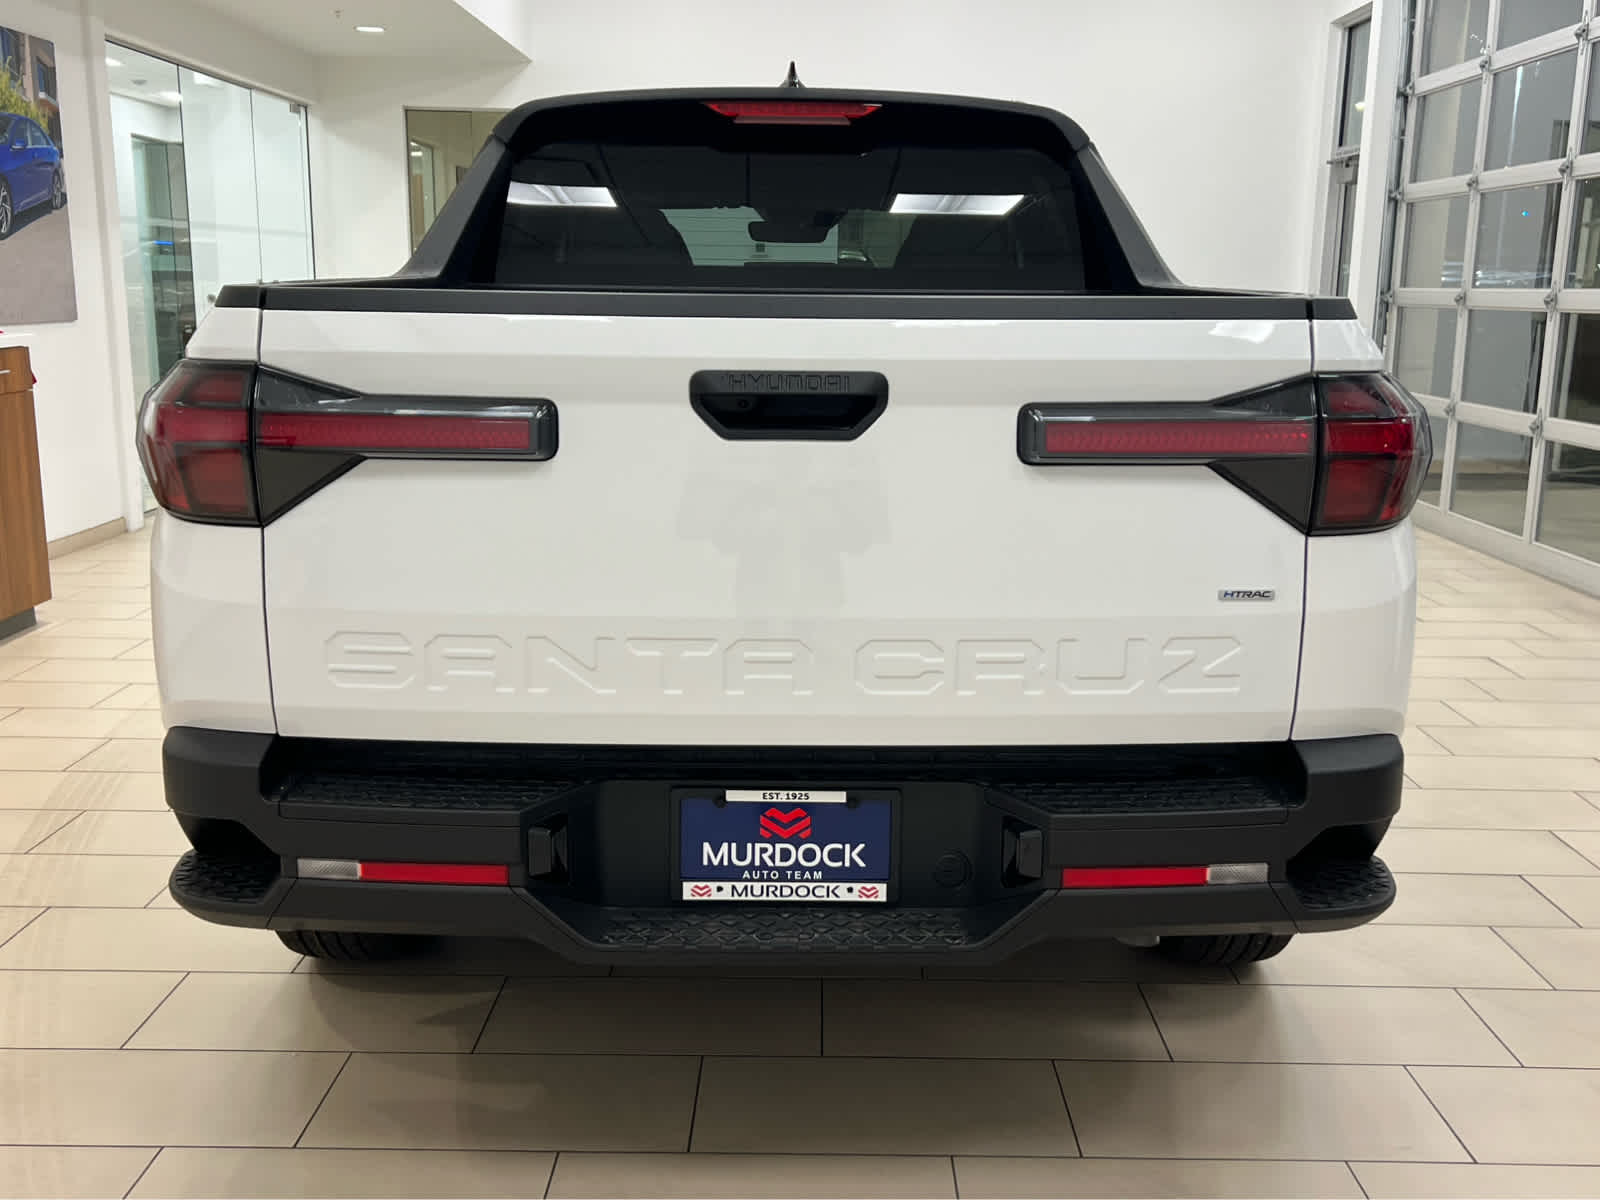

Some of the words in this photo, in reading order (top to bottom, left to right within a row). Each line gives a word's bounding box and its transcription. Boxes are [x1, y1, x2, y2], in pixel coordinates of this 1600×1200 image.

[728, 373, 850, 393] HYUNDAI
[1223, 590, 1273, 599] HTRAC
[324, 631, 814, 695] SANTA
[854, 635, 1243, 696] CRUZ
[761, 792, 784, 801] EST.
[785, 792, 811, 801] 1925
[702, 841, 867, 868] MURDOCK
[742, 870, 780, 880] AUTO
[786, 870, 823, 880] TEAM
[730, 884, 841, 899] MURDOCK
